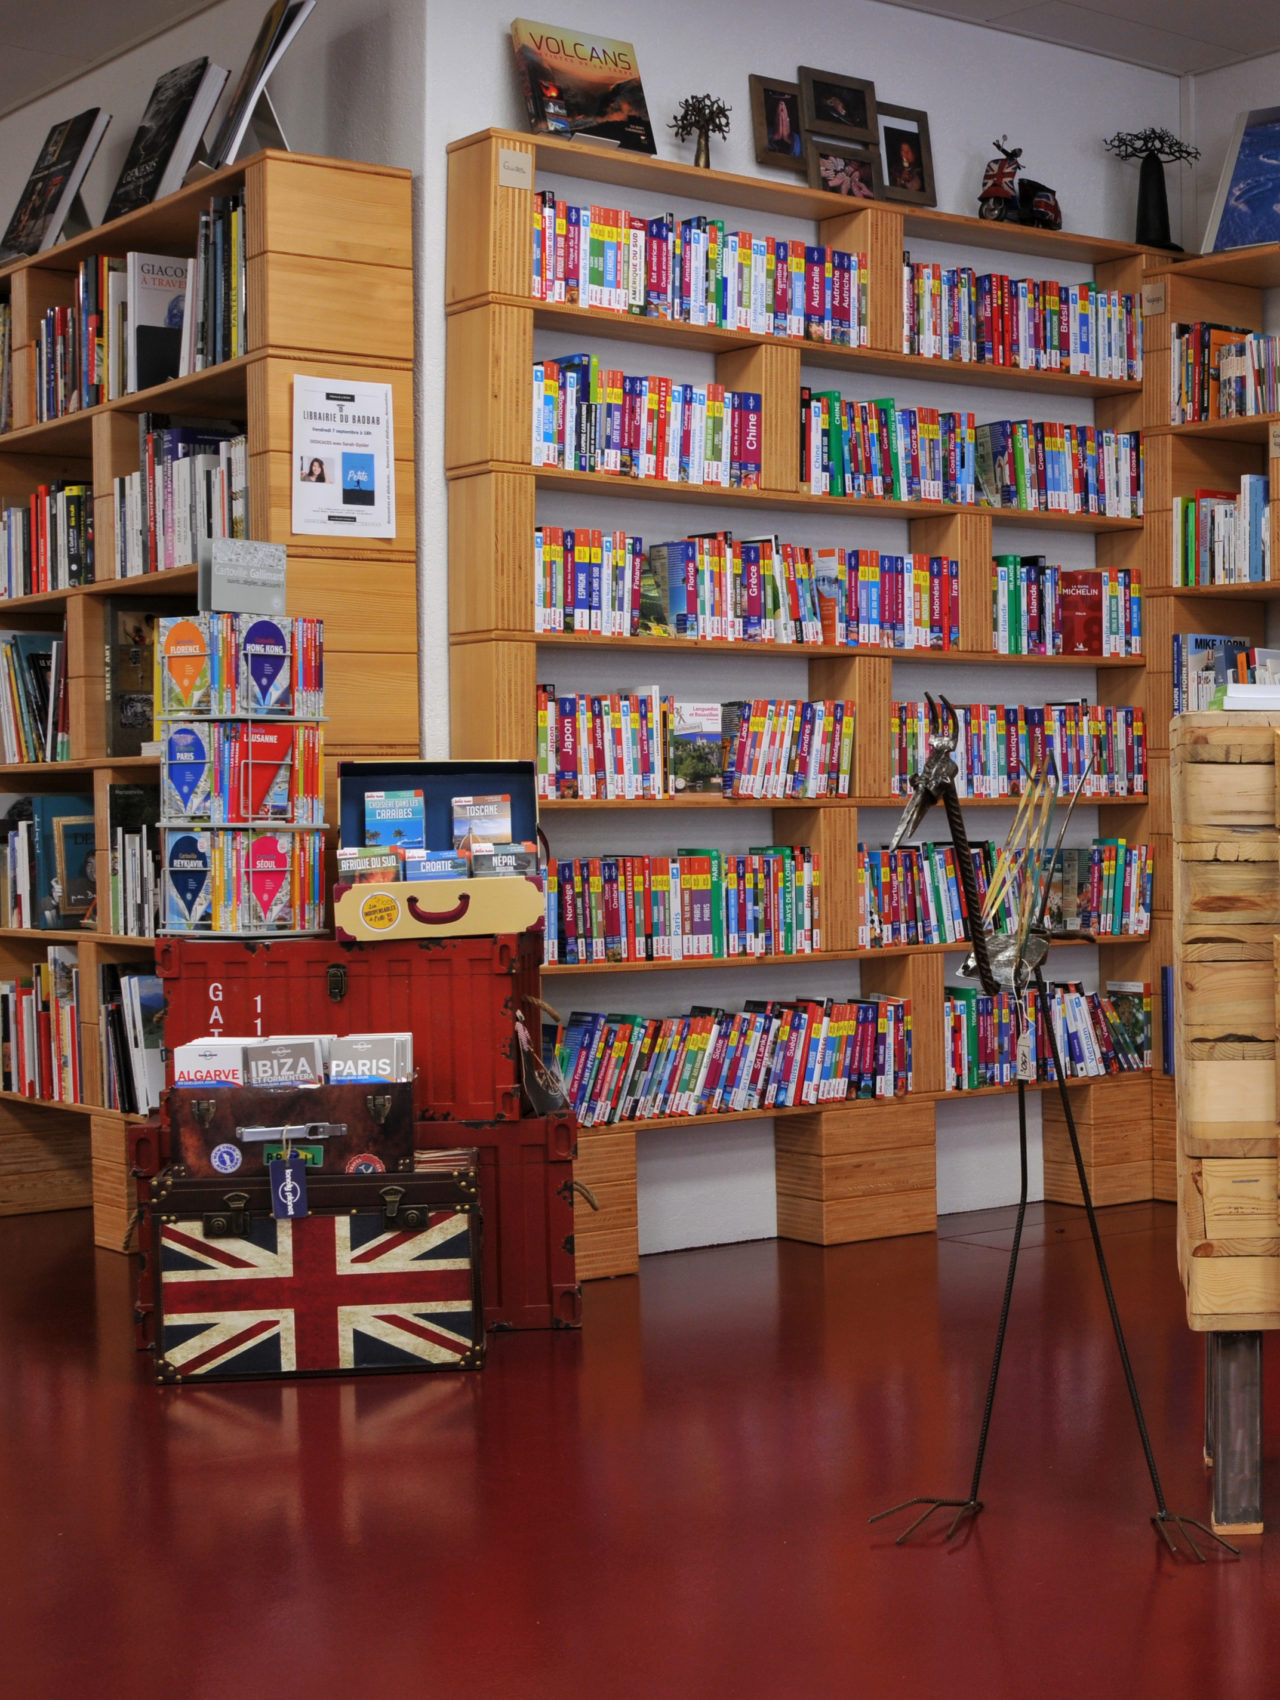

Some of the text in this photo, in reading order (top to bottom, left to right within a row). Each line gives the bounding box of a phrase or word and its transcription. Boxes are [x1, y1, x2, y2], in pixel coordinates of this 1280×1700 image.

[529, 32, 631, 70] VOLCANS
[303, 410, 381, 425] LIBRAIRIE DU BAOBAB
[747, 413, 757, 450] Chine
[347, 470, 369, 482] Petite
[578, 572, 586, 599] ESPAGNE
[749, 565, 757, 597] Grèce
[1062, 588, 1099, 596] MICHELIN
[170, 645, 200, 653] FLORENCE
[246, 644, 283, 653] HONG KONG
[562, 718, 574, 756] Japon
[802, 724, 811, 756] Londres
[176, 752, 194, 760] PARIS
[376, 808, 413, 819] CARAÏBES
[466, 805, 498, 816] TOSCANE
[173, 860, 204, 869] REYKJAVIK
[256, 860, 276, 869] SÉOUL
[341, 858, 370, 870] AFRIQUE
[371, 857, 380, 867] DU
[381, 856, 397, 866] SUD
[420, 860, 452, 872] CROATIE
[492, 855, 517, 867] NÉPAL
[1083, 1028, 1094, 1063] Vietnam
[250, 1057, 312, 1075] IBIZA
[331, 1058, 391, 1076] PARIS
[177, 1069, 240, 1081] ALGARVE
[284, 1168, 294, 1215] lonely planet
